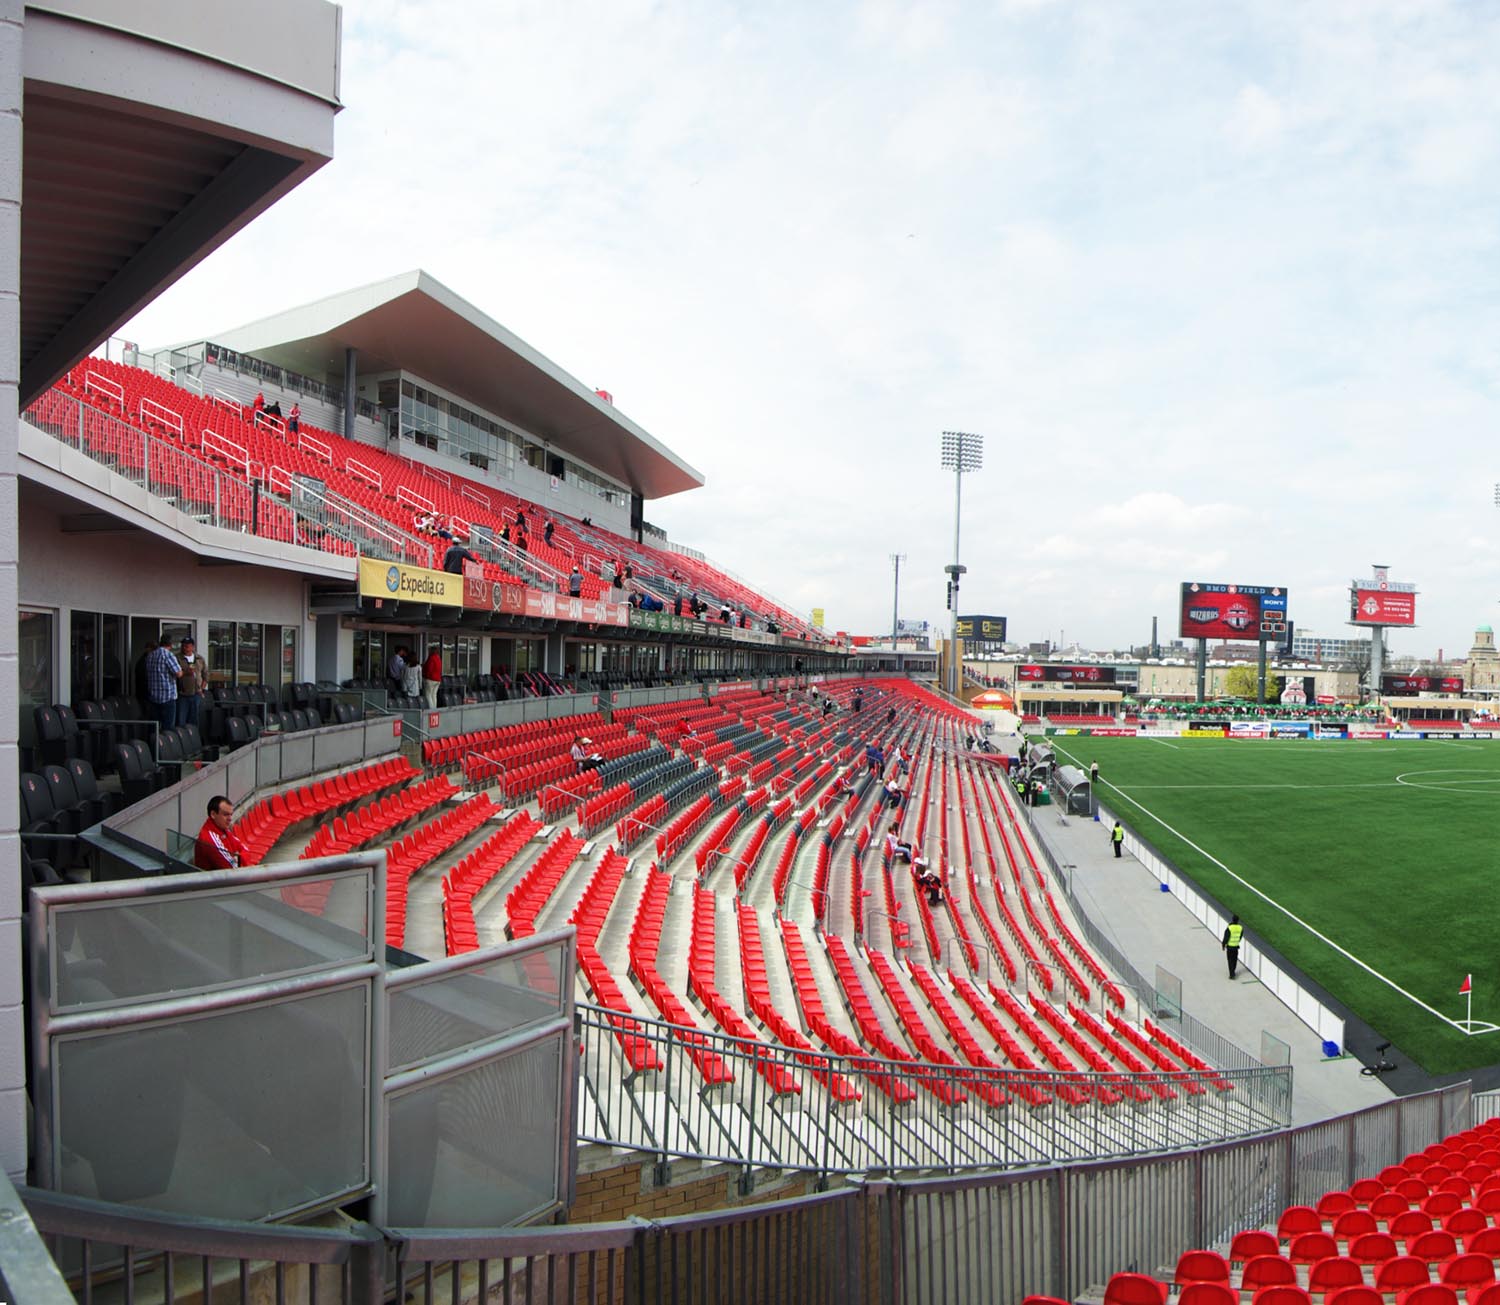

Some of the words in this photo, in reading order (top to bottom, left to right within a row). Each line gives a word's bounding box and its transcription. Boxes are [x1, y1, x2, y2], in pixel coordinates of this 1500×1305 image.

[401, 572, 445, 597] Expedia.ca
[469, 579, 488, 602] ESQ
[506, 585, 522, 608] ESQ
